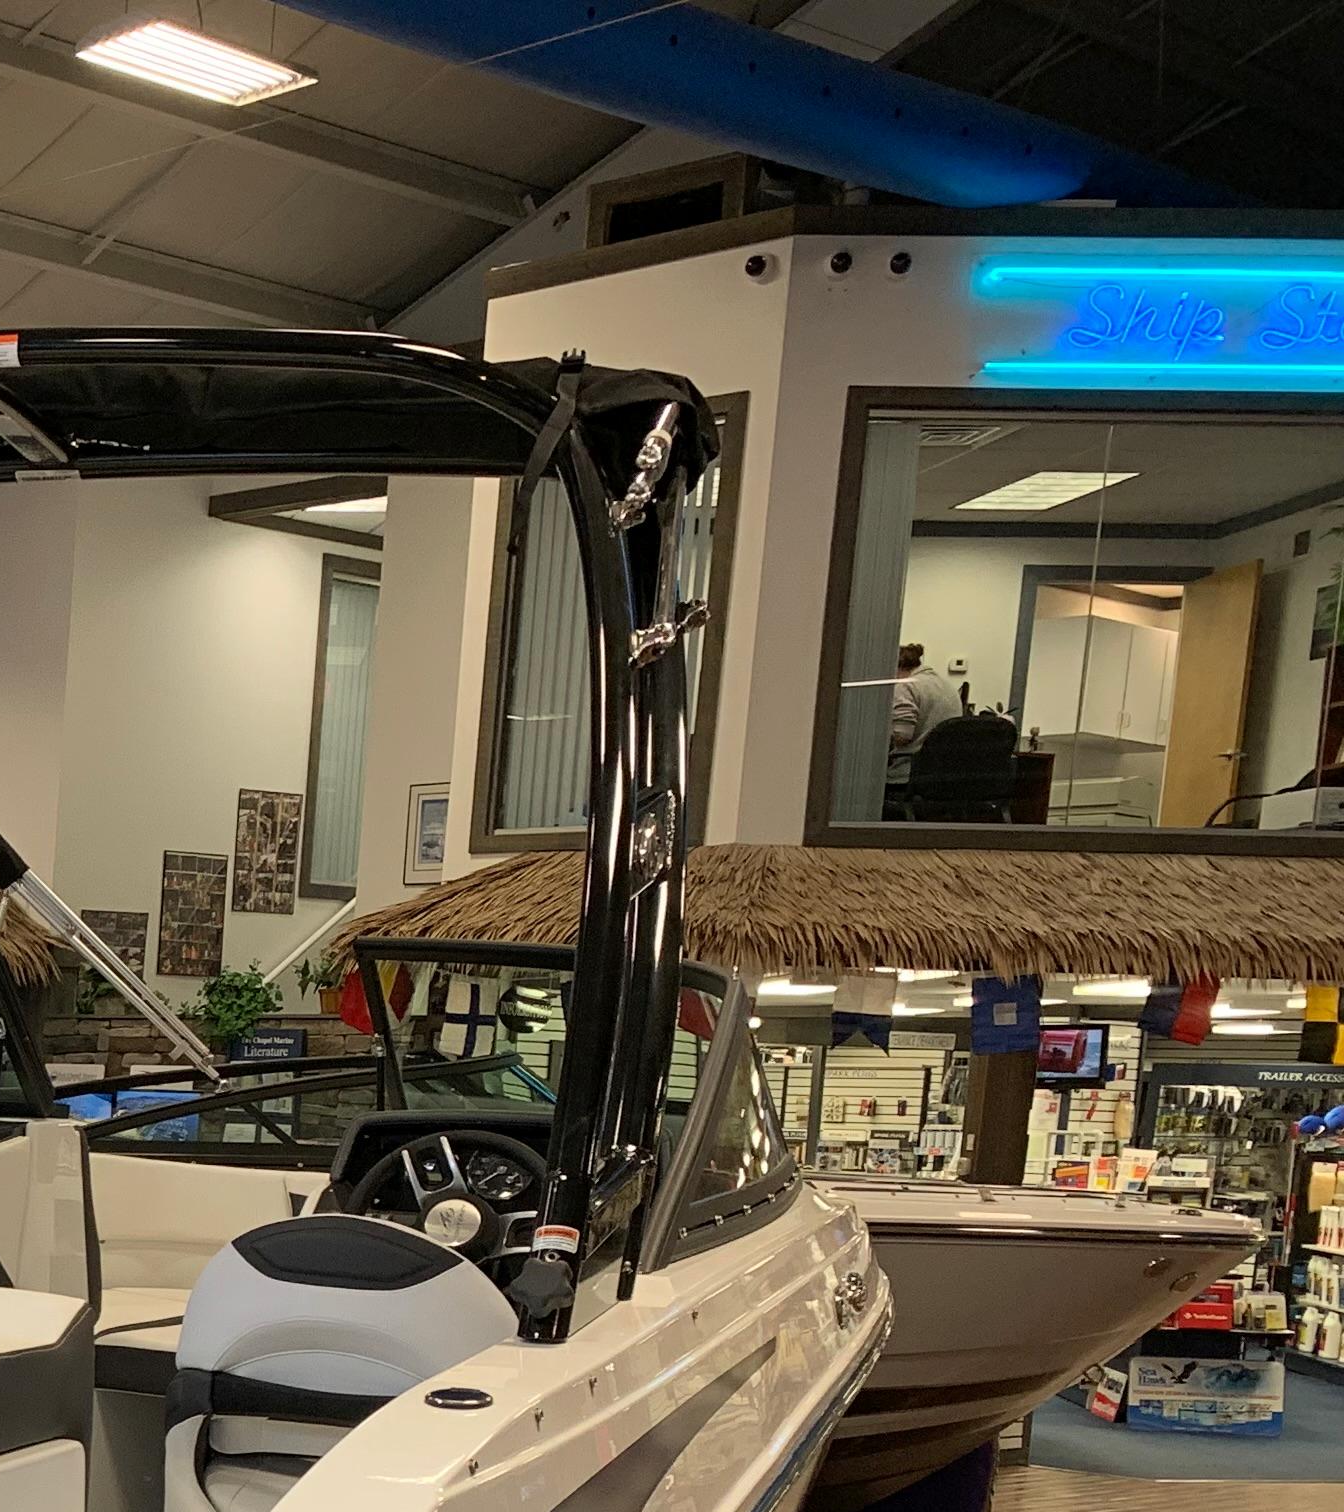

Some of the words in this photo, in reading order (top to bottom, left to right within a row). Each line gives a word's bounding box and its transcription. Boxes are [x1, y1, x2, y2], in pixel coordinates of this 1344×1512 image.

[1068, 285, 1225, 361] Ship
[1261, 286, 1344, 350] St
[253, 1036, 272, 1045] Chapel
[244, 1046, 289, 1057] Literature
[1258, 1071, 1304, 1081] TRAILER
